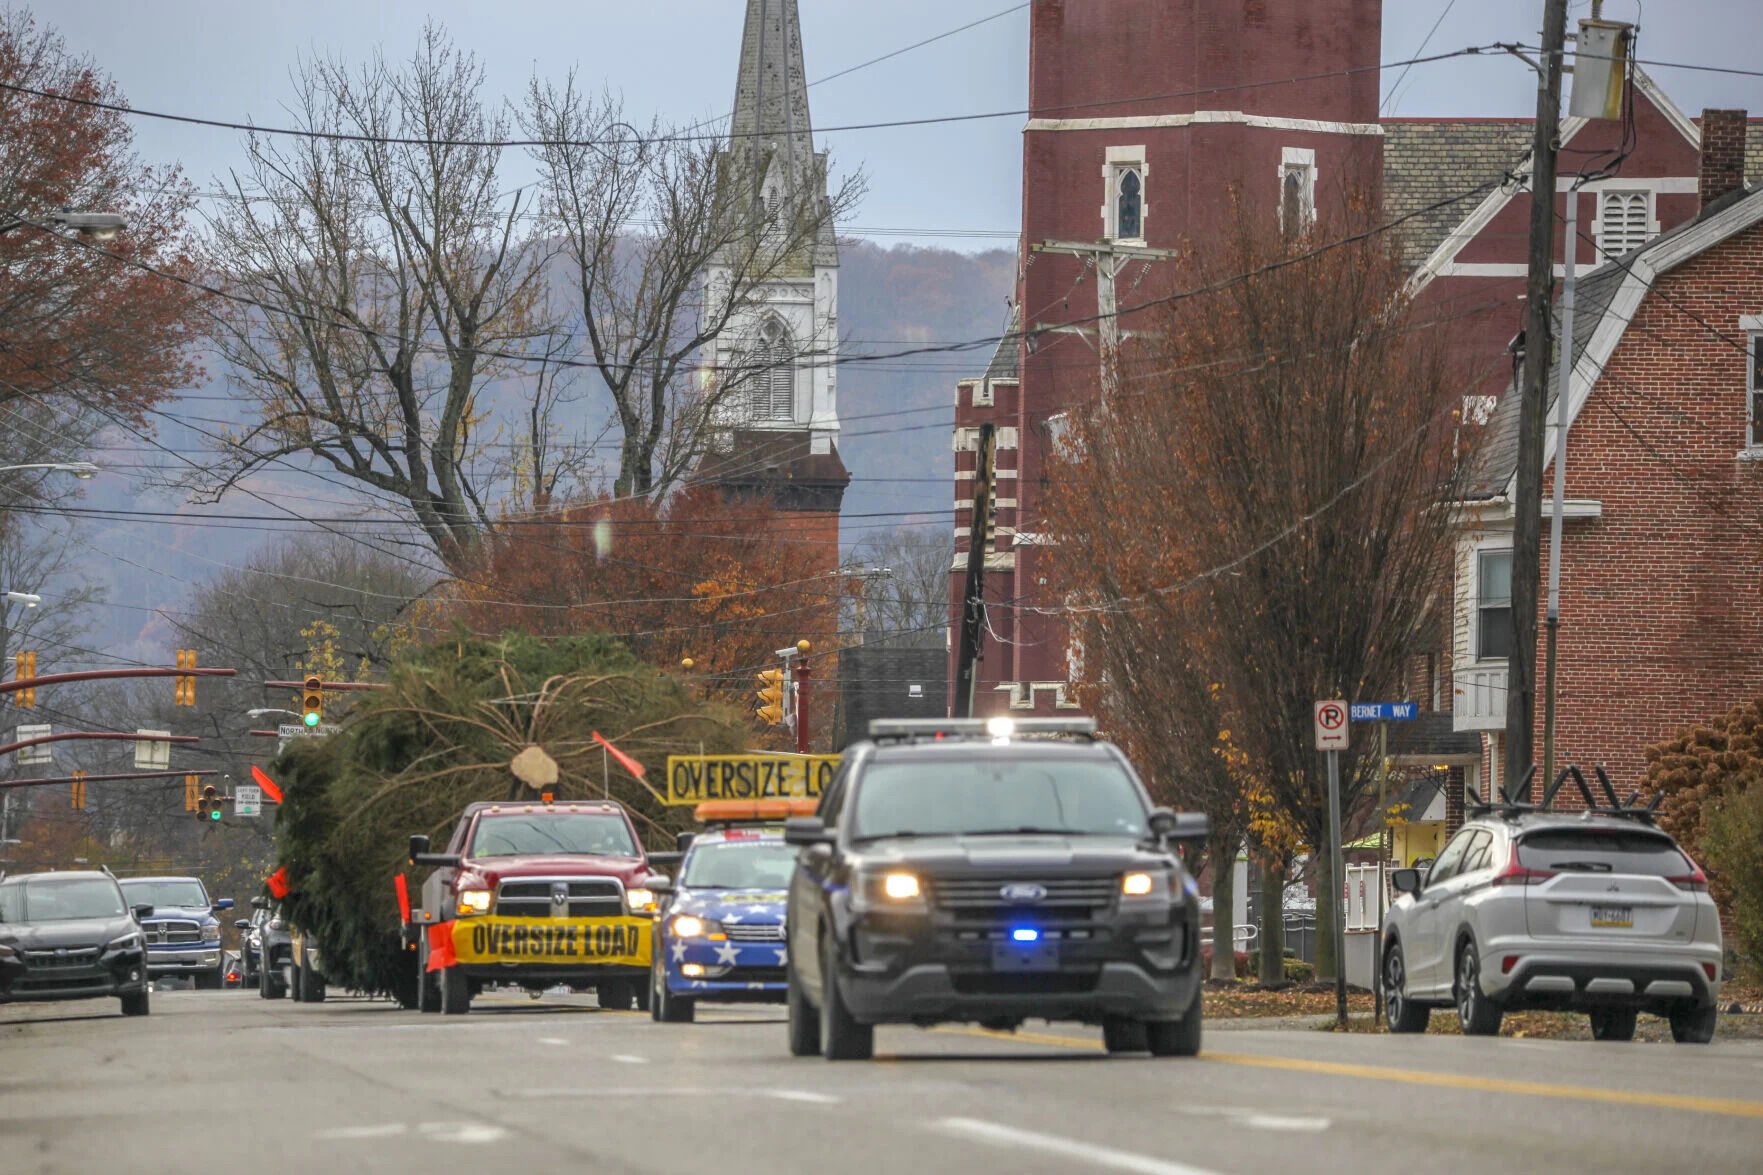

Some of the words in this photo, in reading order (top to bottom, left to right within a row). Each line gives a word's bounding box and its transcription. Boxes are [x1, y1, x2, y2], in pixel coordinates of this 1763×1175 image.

[1351, 705, 1381, 717] BERNET
[1392, 705, 1410, 717] WAY
[280, 726, 304, 735] NORTH
[673, 760, 791, 798] OVERSIZE
[804, 759, 834, 797] LO
[473, 923, 577, 956] OVERSIZE
[583, 925, 639, 957] LOAD
